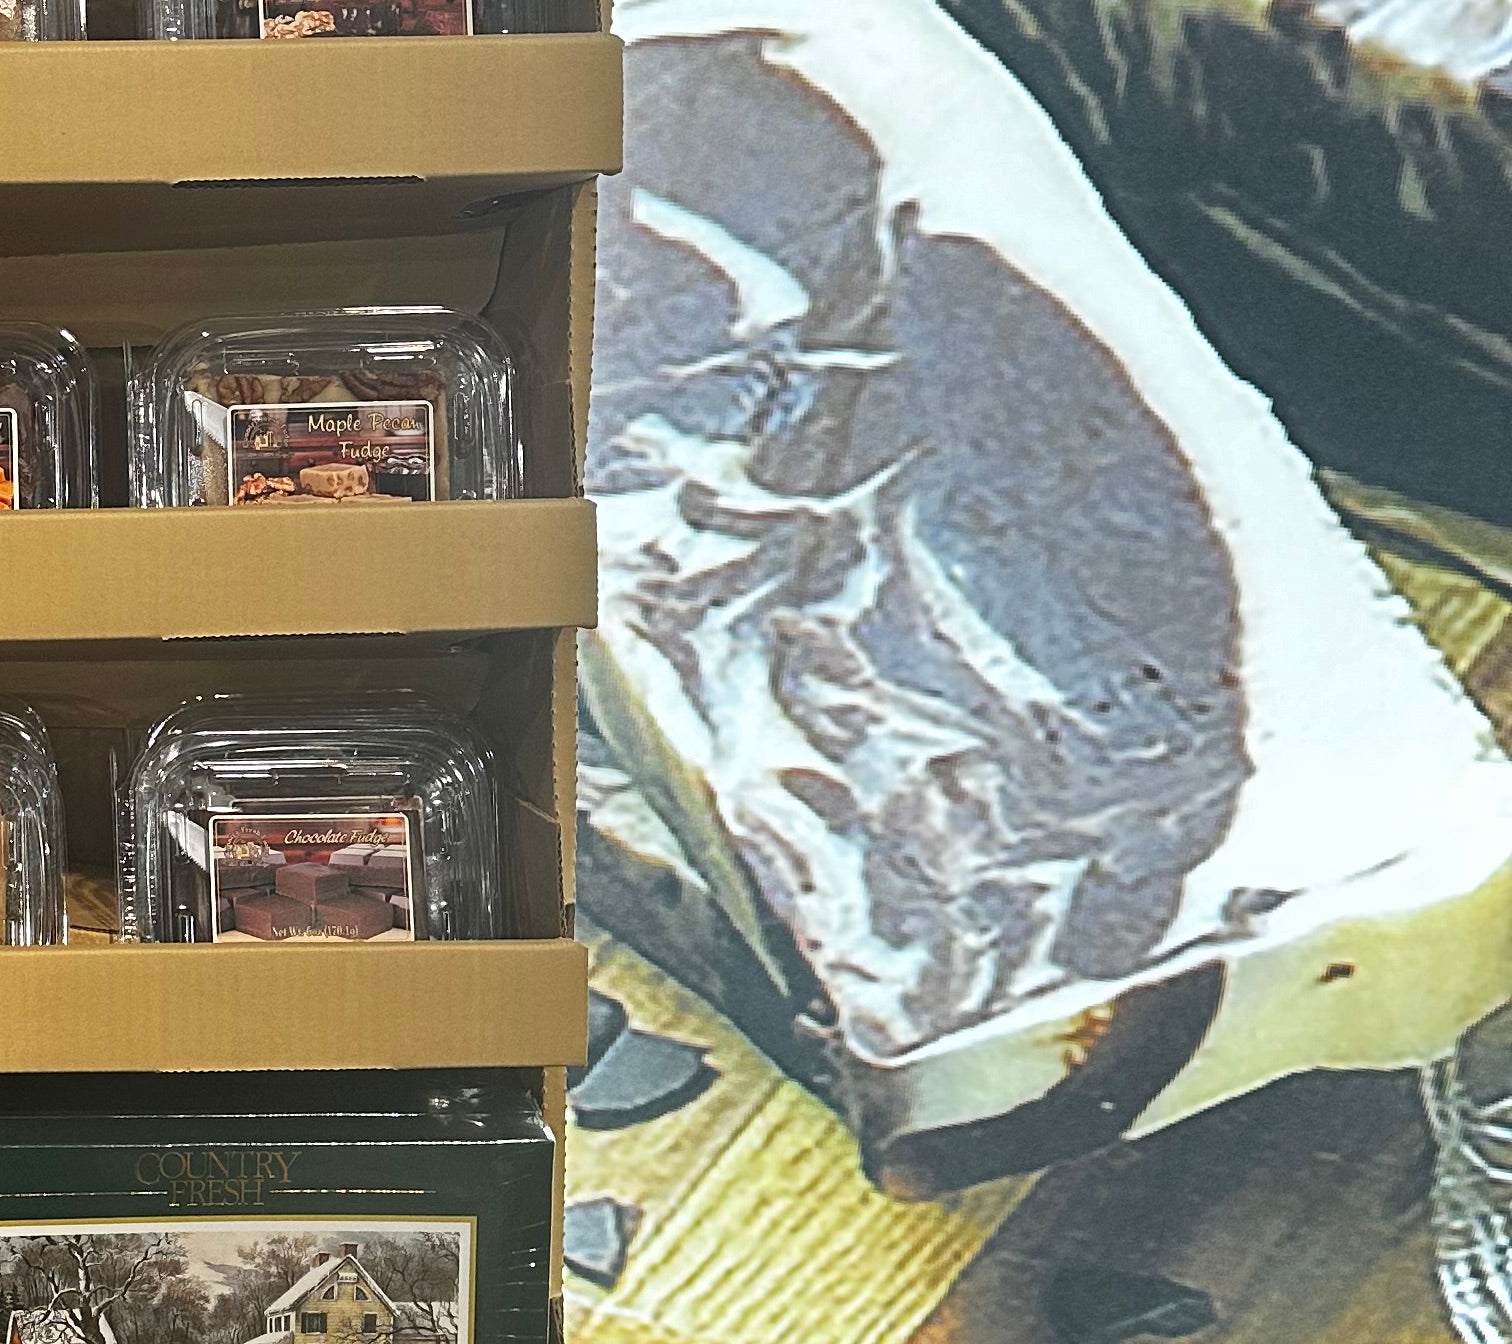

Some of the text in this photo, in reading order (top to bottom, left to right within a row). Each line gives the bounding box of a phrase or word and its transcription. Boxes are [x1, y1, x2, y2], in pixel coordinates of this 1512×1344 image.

[308, 413, 361, 437] Maple
[368, 413, 423, 432] Pecan
[339, 440, 390, 463] Fudge
[284, 828, 389, 847] Chocolate Fudge
[136, 1151, 302, 1186] COUNTRY
[169, 1179, 265, 1206] FRESH
